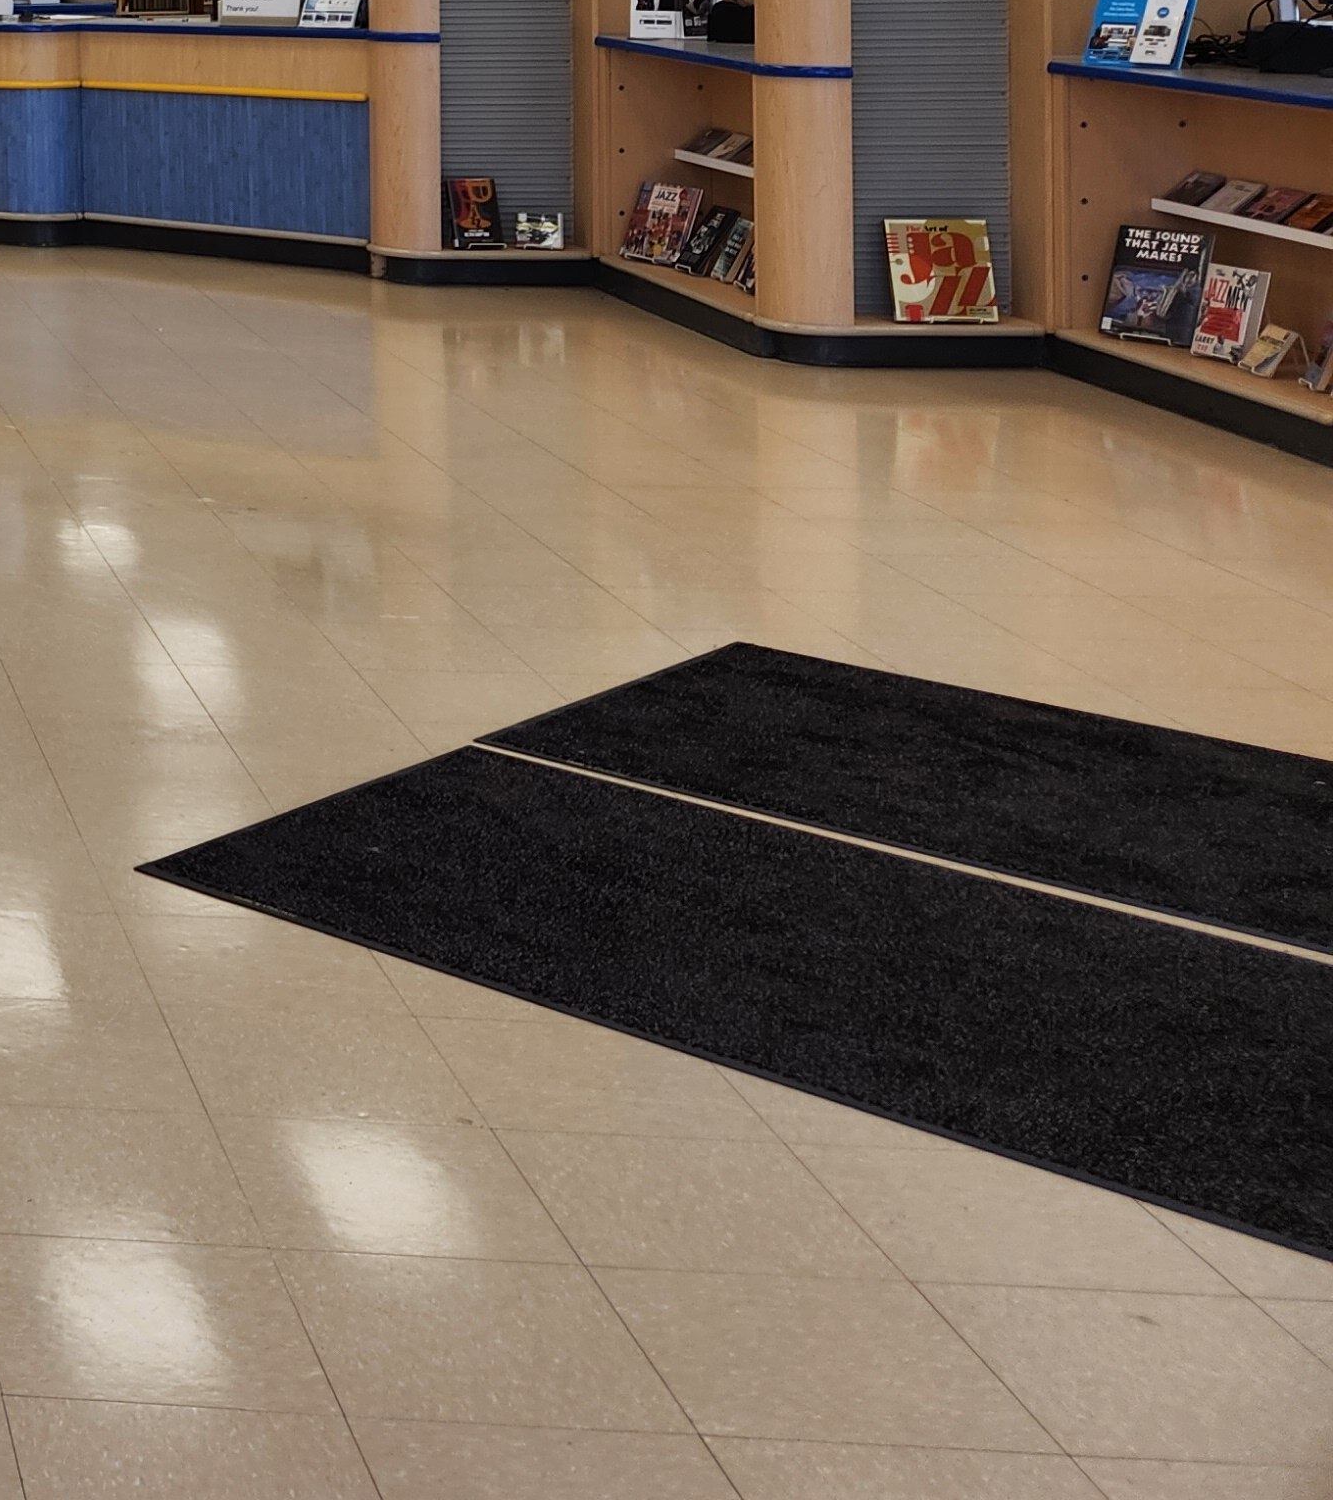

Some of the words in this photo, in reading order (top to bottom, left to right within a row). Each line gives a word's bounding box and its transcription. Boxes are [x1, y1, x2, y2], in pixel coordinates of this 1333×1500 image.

[655, 190, 677, 202] JAZZ
[1128, 228, 1153, 239] THE
[1155, 230, 1202, 244] SOUND
[1124, 238, 1159, 250] THAT
[1162, 240, 1200, 255] JAZZ
[1136, 250, 1183, 263] MAKES
[1195, 335, 1215, 345] LARRY
